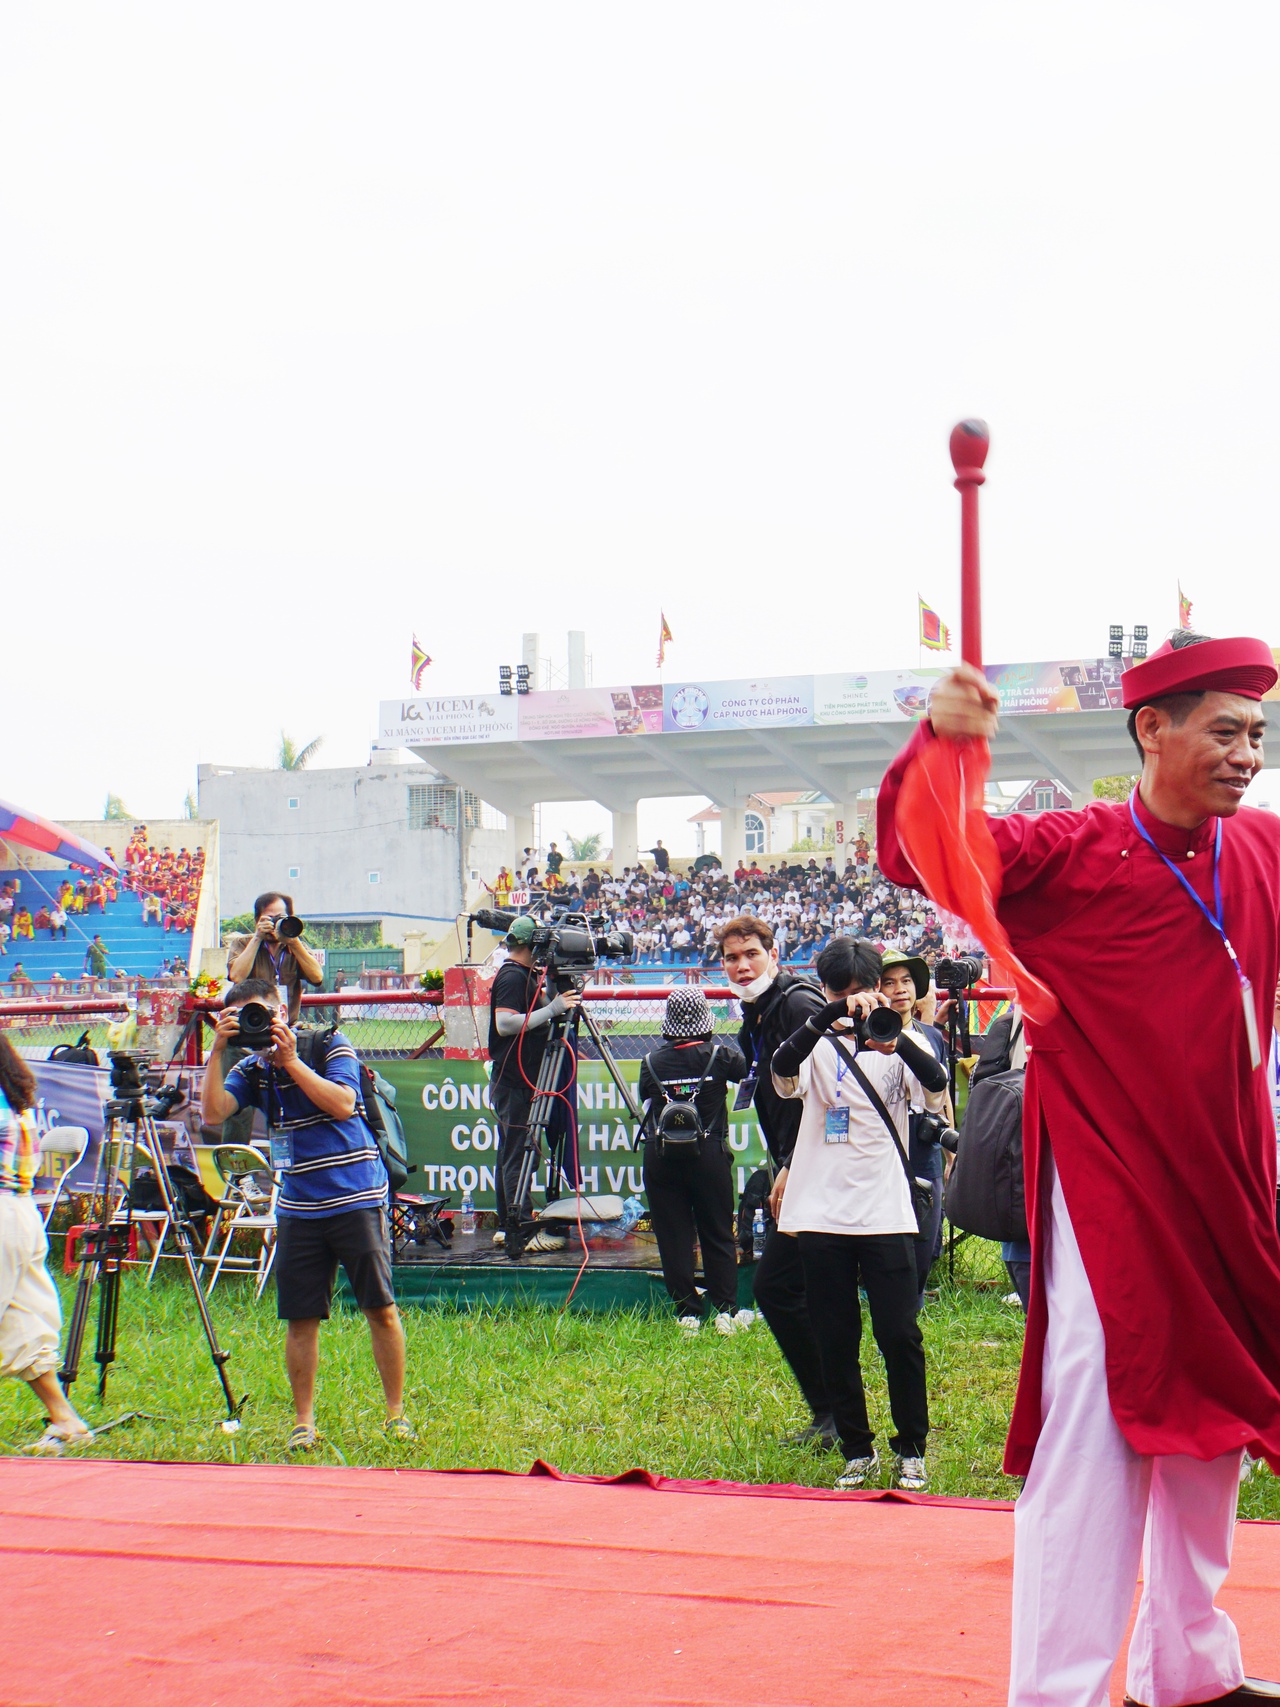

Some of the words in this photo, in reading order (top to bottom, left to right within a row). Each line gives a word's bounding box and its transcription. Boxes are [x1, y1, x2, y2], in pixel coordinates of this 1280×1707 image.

[1007, 686, 1022, 697] TRÀ
[1023, 687, 1035, 696] CA
[1036, 686, 1060, 697] NHẠC
[426, 699, 474, 713] VICEM
[722, 698, 746, 707] CÔNG
[1005, 697, 1018, 707] HẢI
[1019, 696, 1049, 707] PHÒNG
[777, 706, 808, 715] PHÒNG
[426, 725, 457, 735] VICEM
[479, 721, 513, 732] PHÒNG
[512, 892, 527, 904] WC
[424, 1165, 497, 1192] TRON
